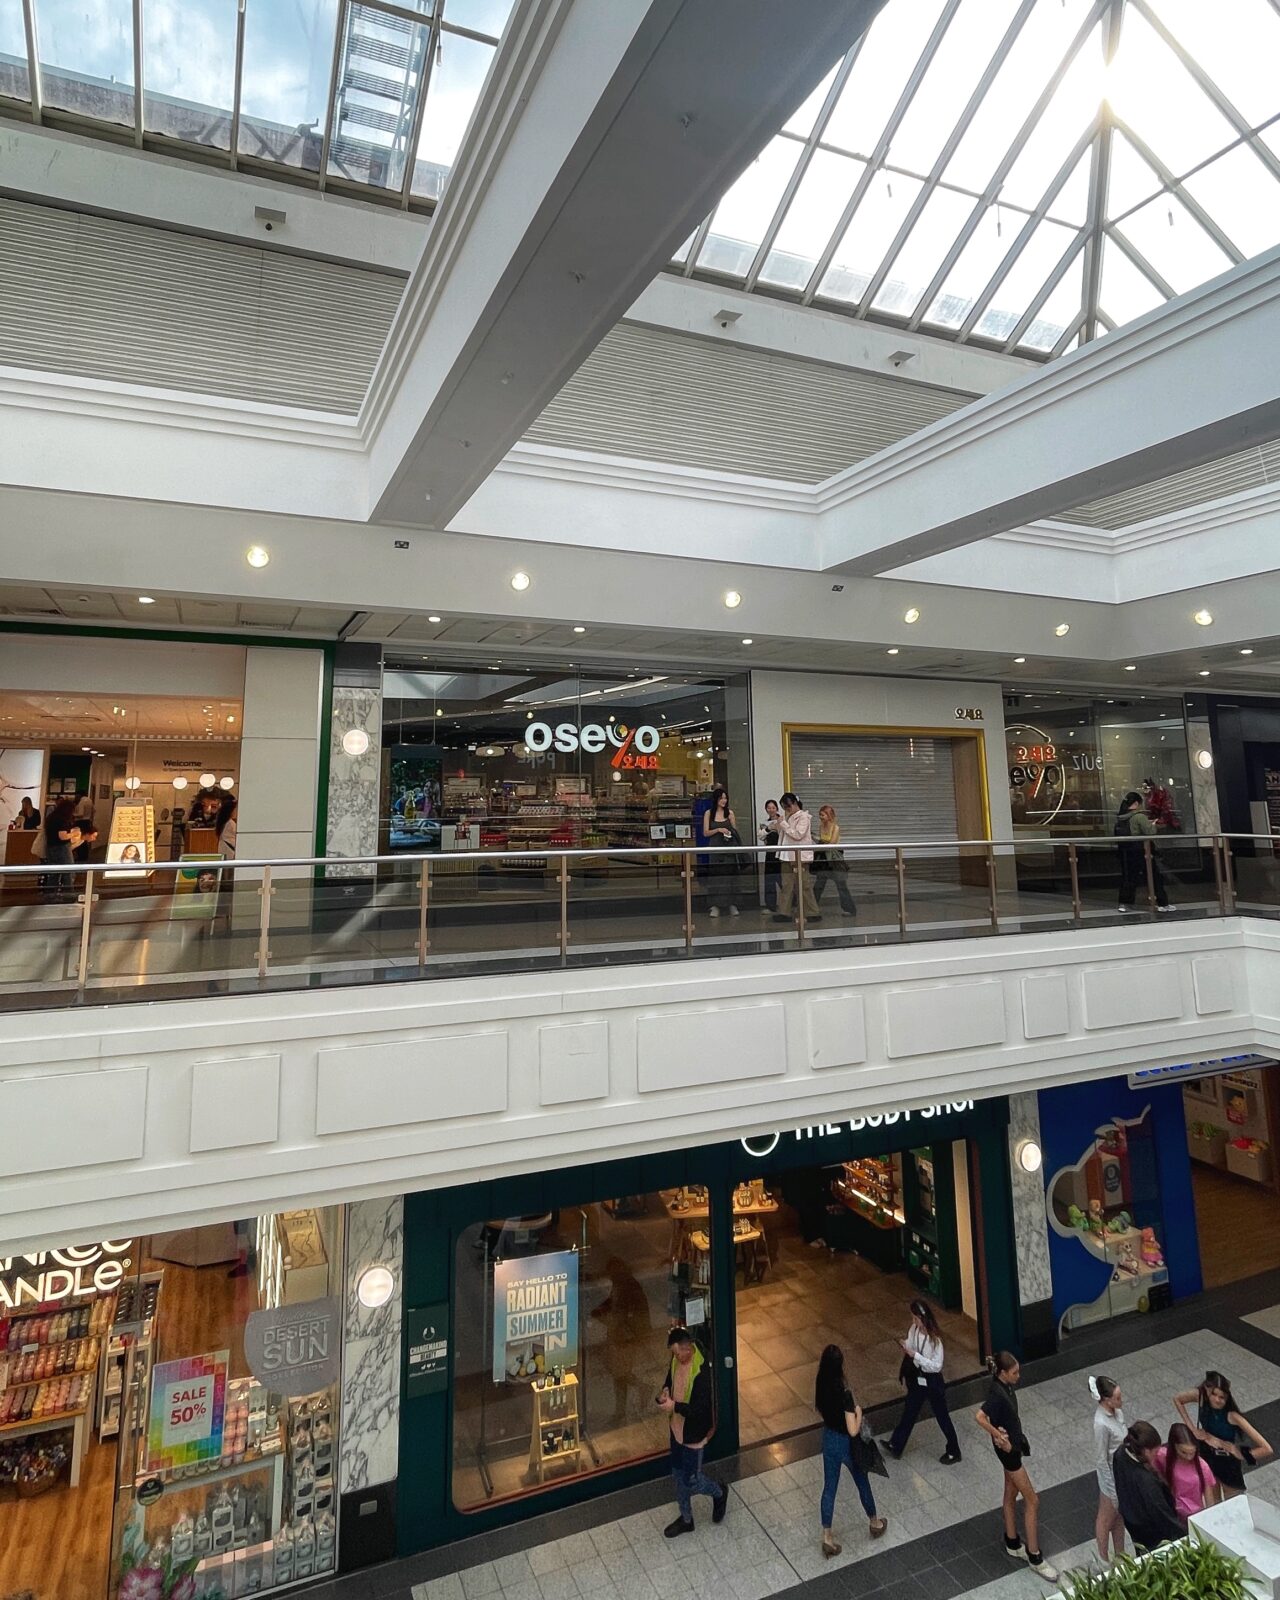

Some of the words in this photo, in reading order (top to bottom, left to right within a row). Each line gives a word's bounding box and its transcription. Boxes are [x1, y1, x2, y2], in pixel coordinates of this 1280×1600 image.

[524, 722, 660, 768] oseyo
[621, 755, 659, 769] 오세요
[506, 1281, 524, 1289] SAY
[525, 1275, 554, 1286] HELLO
[555, 1272, 568, 1280] TO
[506, 1280, 568, 1313] RADIANT
[264, 1318, 330, 1345] DESERT
[510, 1309, 564, 1337] SUMMER
[263, 1333, 328, 1369] SUN
[544, 1332, 567, 1352] IN
[172, 1386, 207, 1404] SALE
[170, 1402, 207, 1426] 50%
